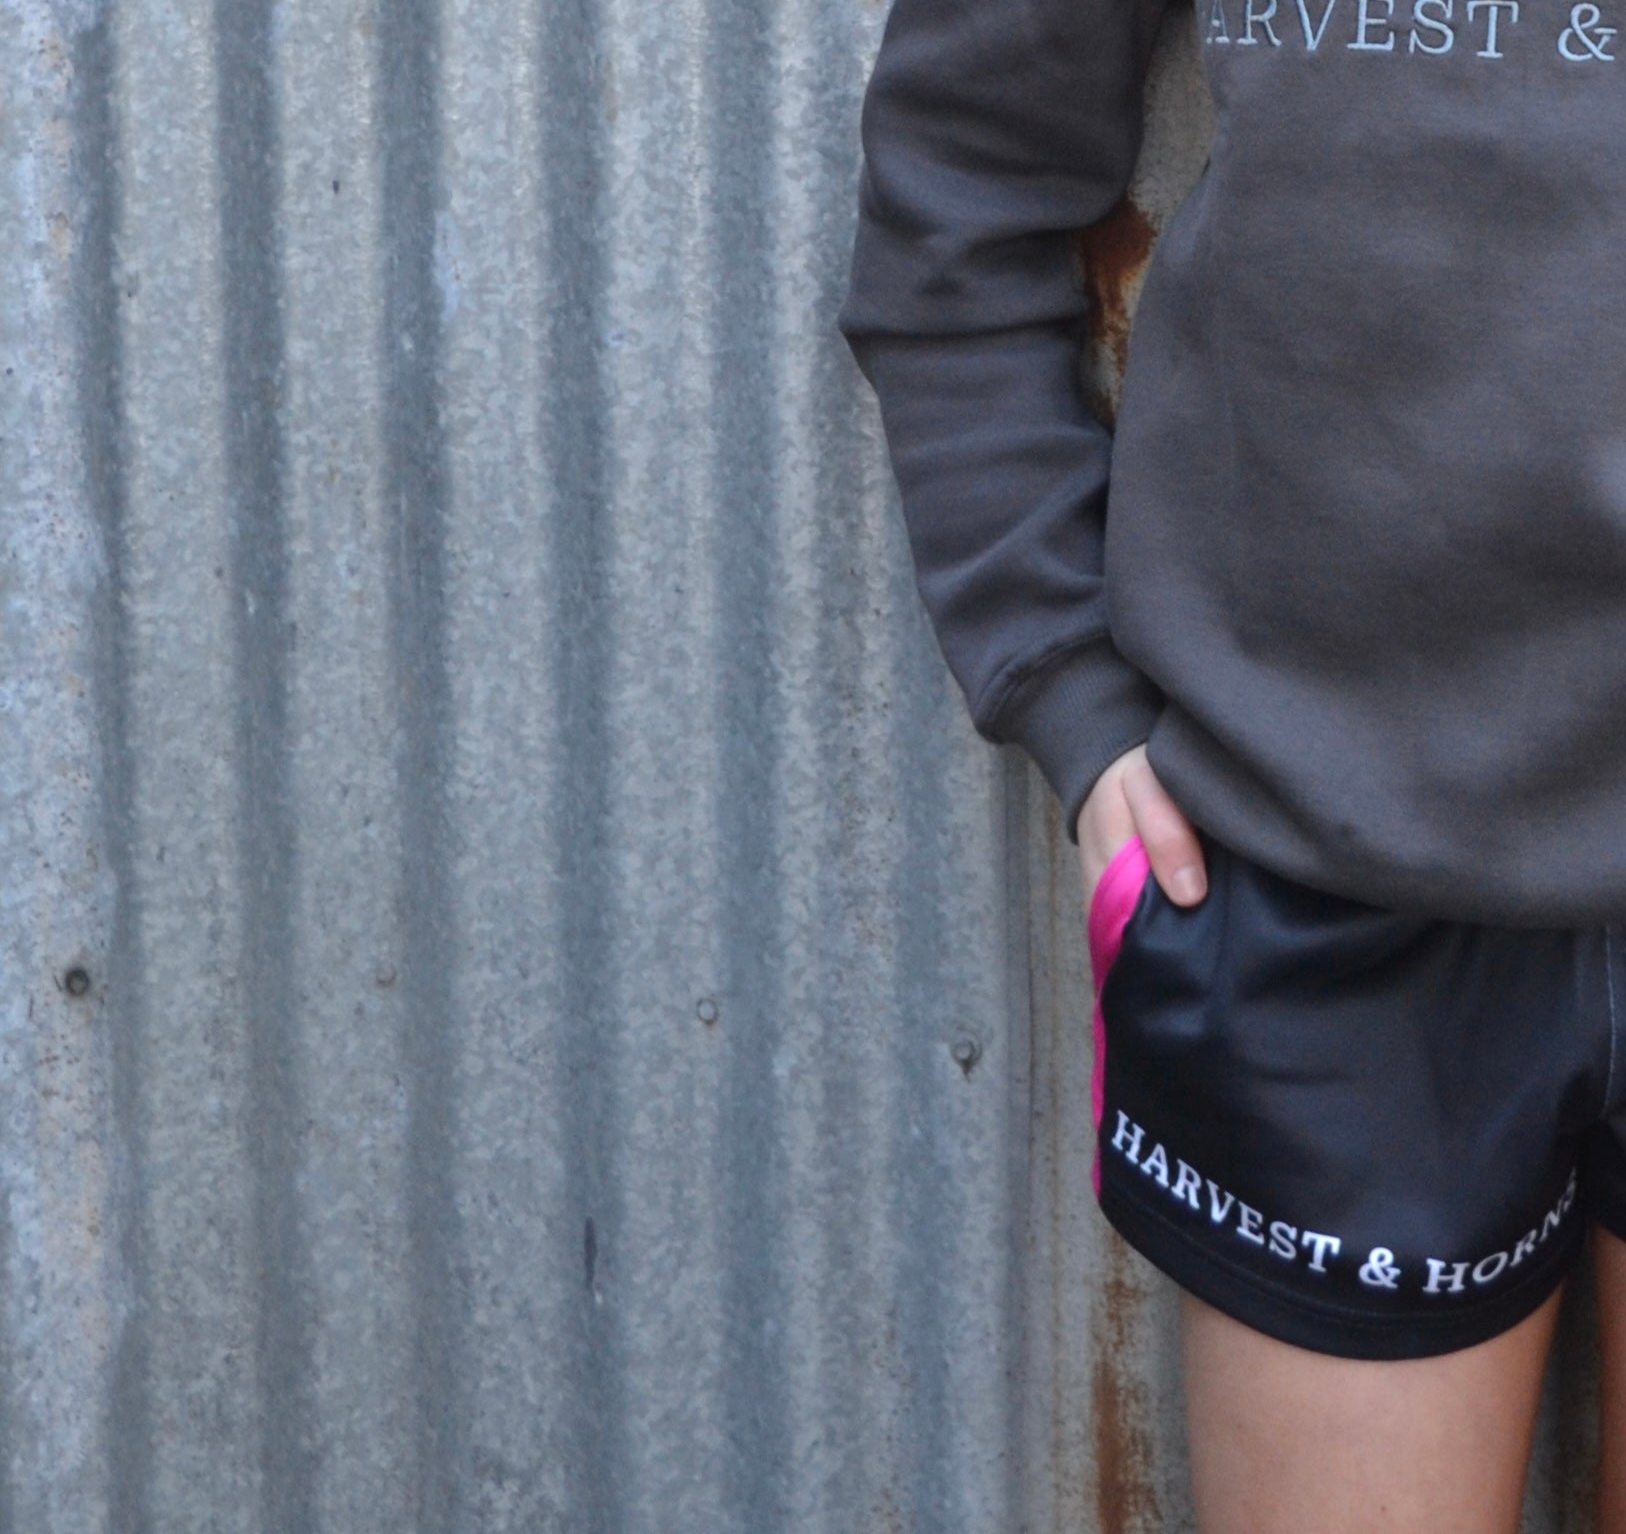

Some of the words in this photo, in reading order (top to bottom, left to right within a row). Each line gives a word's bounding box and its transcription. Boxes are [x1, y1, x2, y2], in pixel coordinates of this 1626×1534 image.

[1556, 2, 1617, 62] &
[1111, 1109, 1341, 1273] HARVEST
[1358, 1246, 1401, 1290] &
